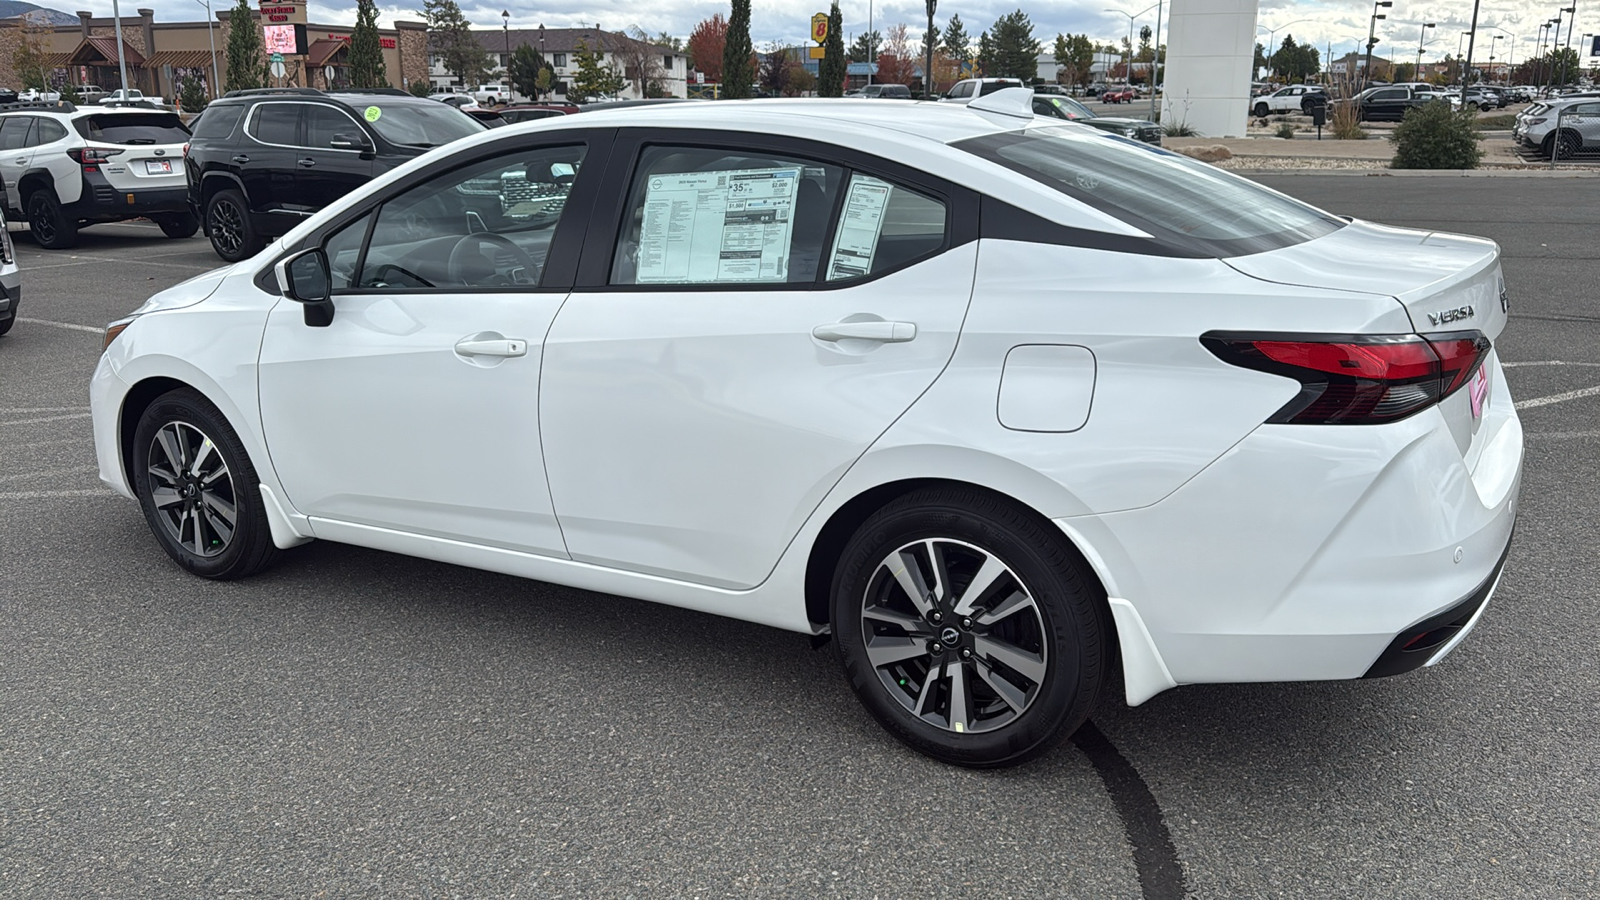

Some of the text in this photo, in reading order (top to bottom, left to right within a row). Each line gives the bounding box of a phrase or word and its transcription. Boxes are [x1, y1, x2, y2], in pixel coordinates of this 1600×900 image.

[816, 22, 826, 37] 8
[733, 183, 744, 192] 35
[1427, 305, 1475, 326] VERSA
